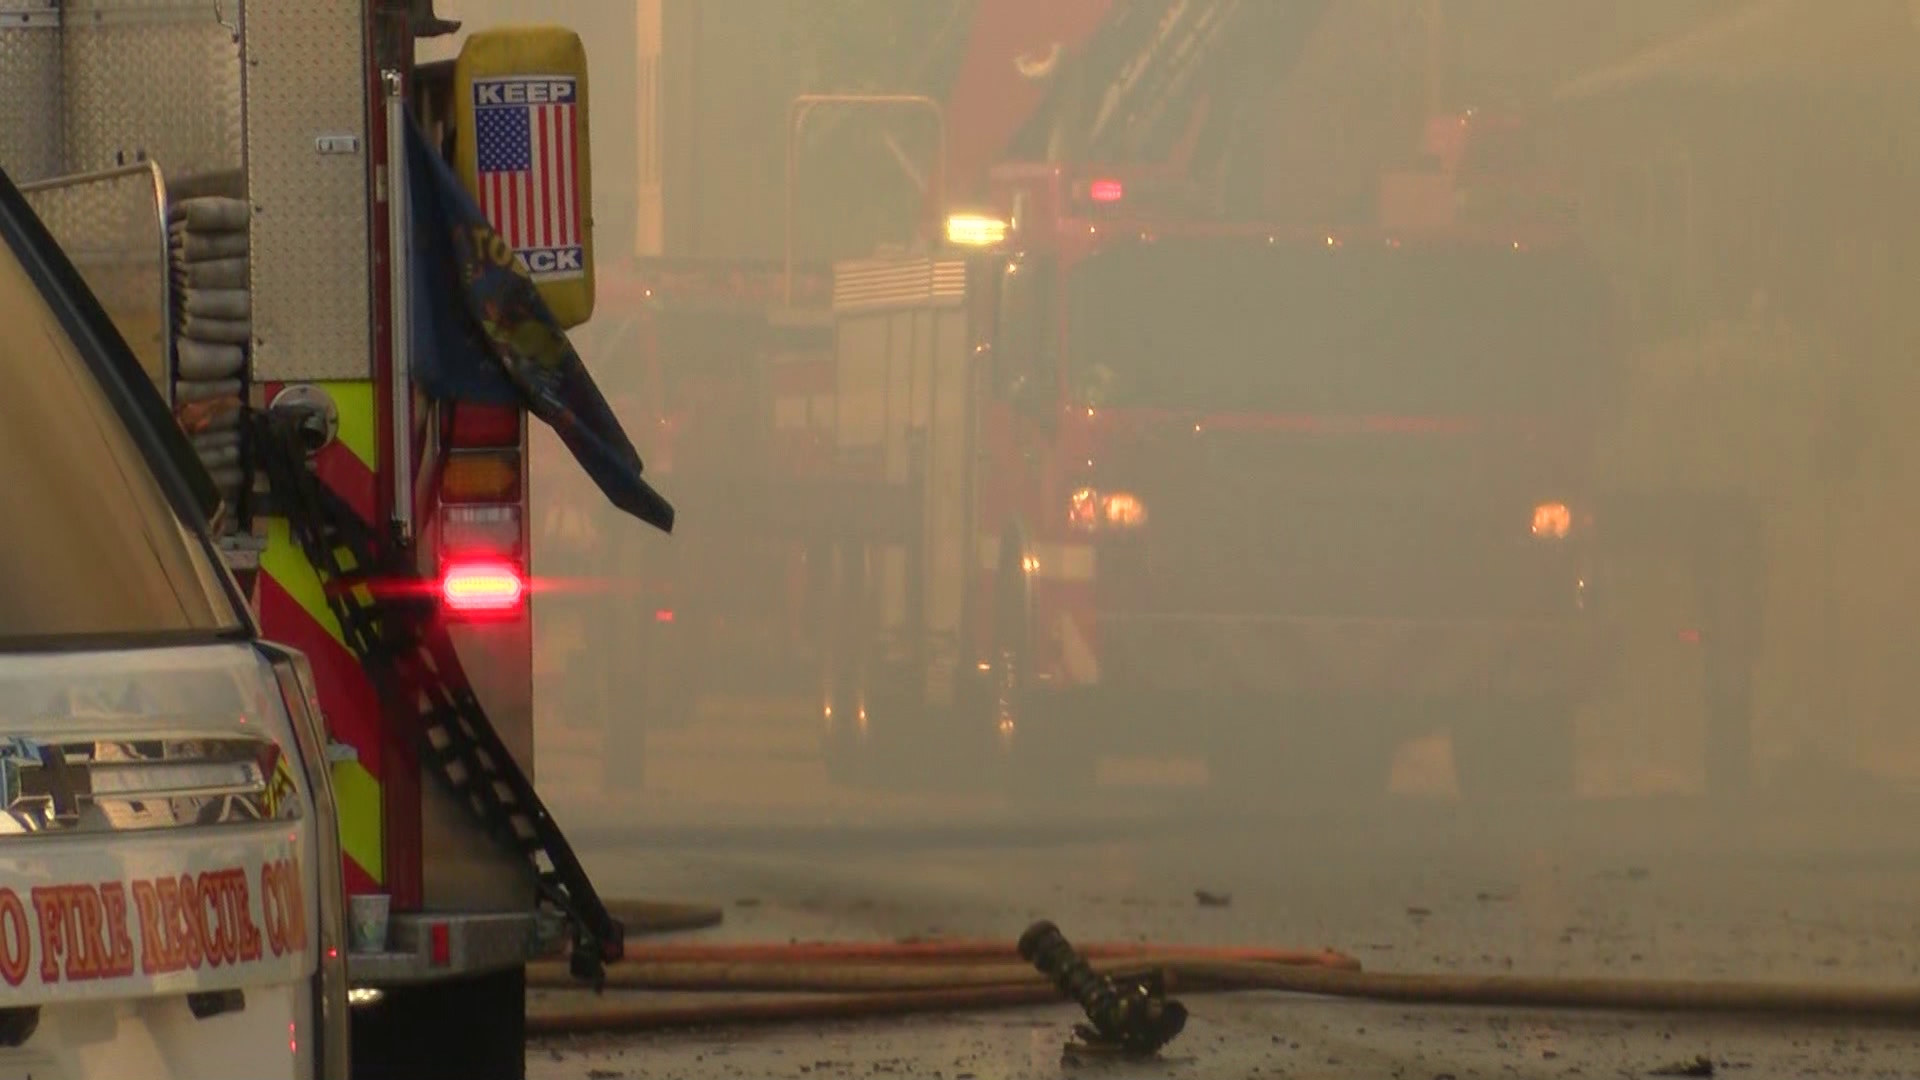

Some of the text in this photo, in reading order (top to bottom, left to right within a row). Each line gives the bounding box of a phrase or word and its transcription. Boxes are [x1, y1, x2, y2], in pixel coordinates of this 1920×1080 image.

[478, 83, 572, 104] KEEP
[513, 250, 580, 272] ACK
[32, 881, 133, 983] FIRE
